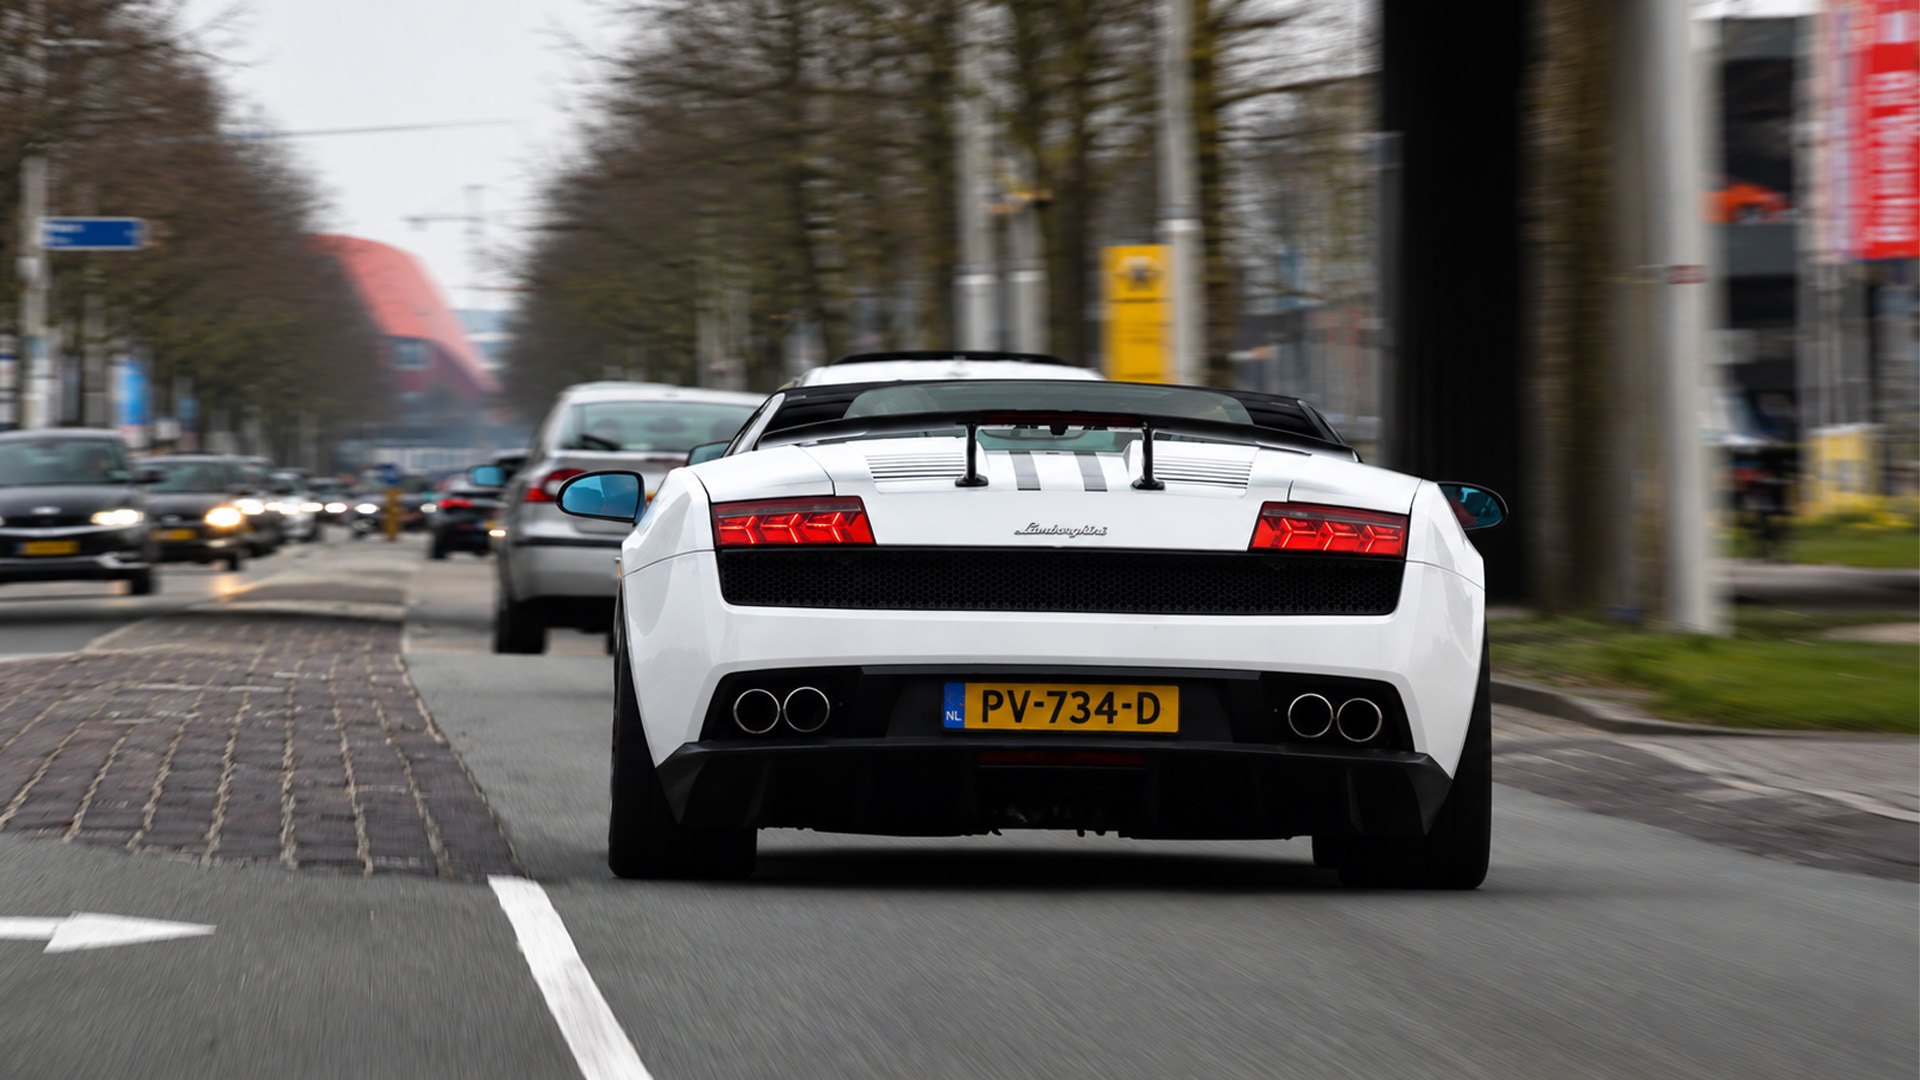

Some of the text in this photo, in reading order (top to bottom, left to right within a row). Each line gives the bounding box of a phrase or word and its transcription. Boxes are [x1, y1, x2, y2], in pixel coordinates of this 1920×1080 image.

[1014, 522, 1108, 538] Lamborghini
[946, 689, 1160, 725] NL PV-734-D
